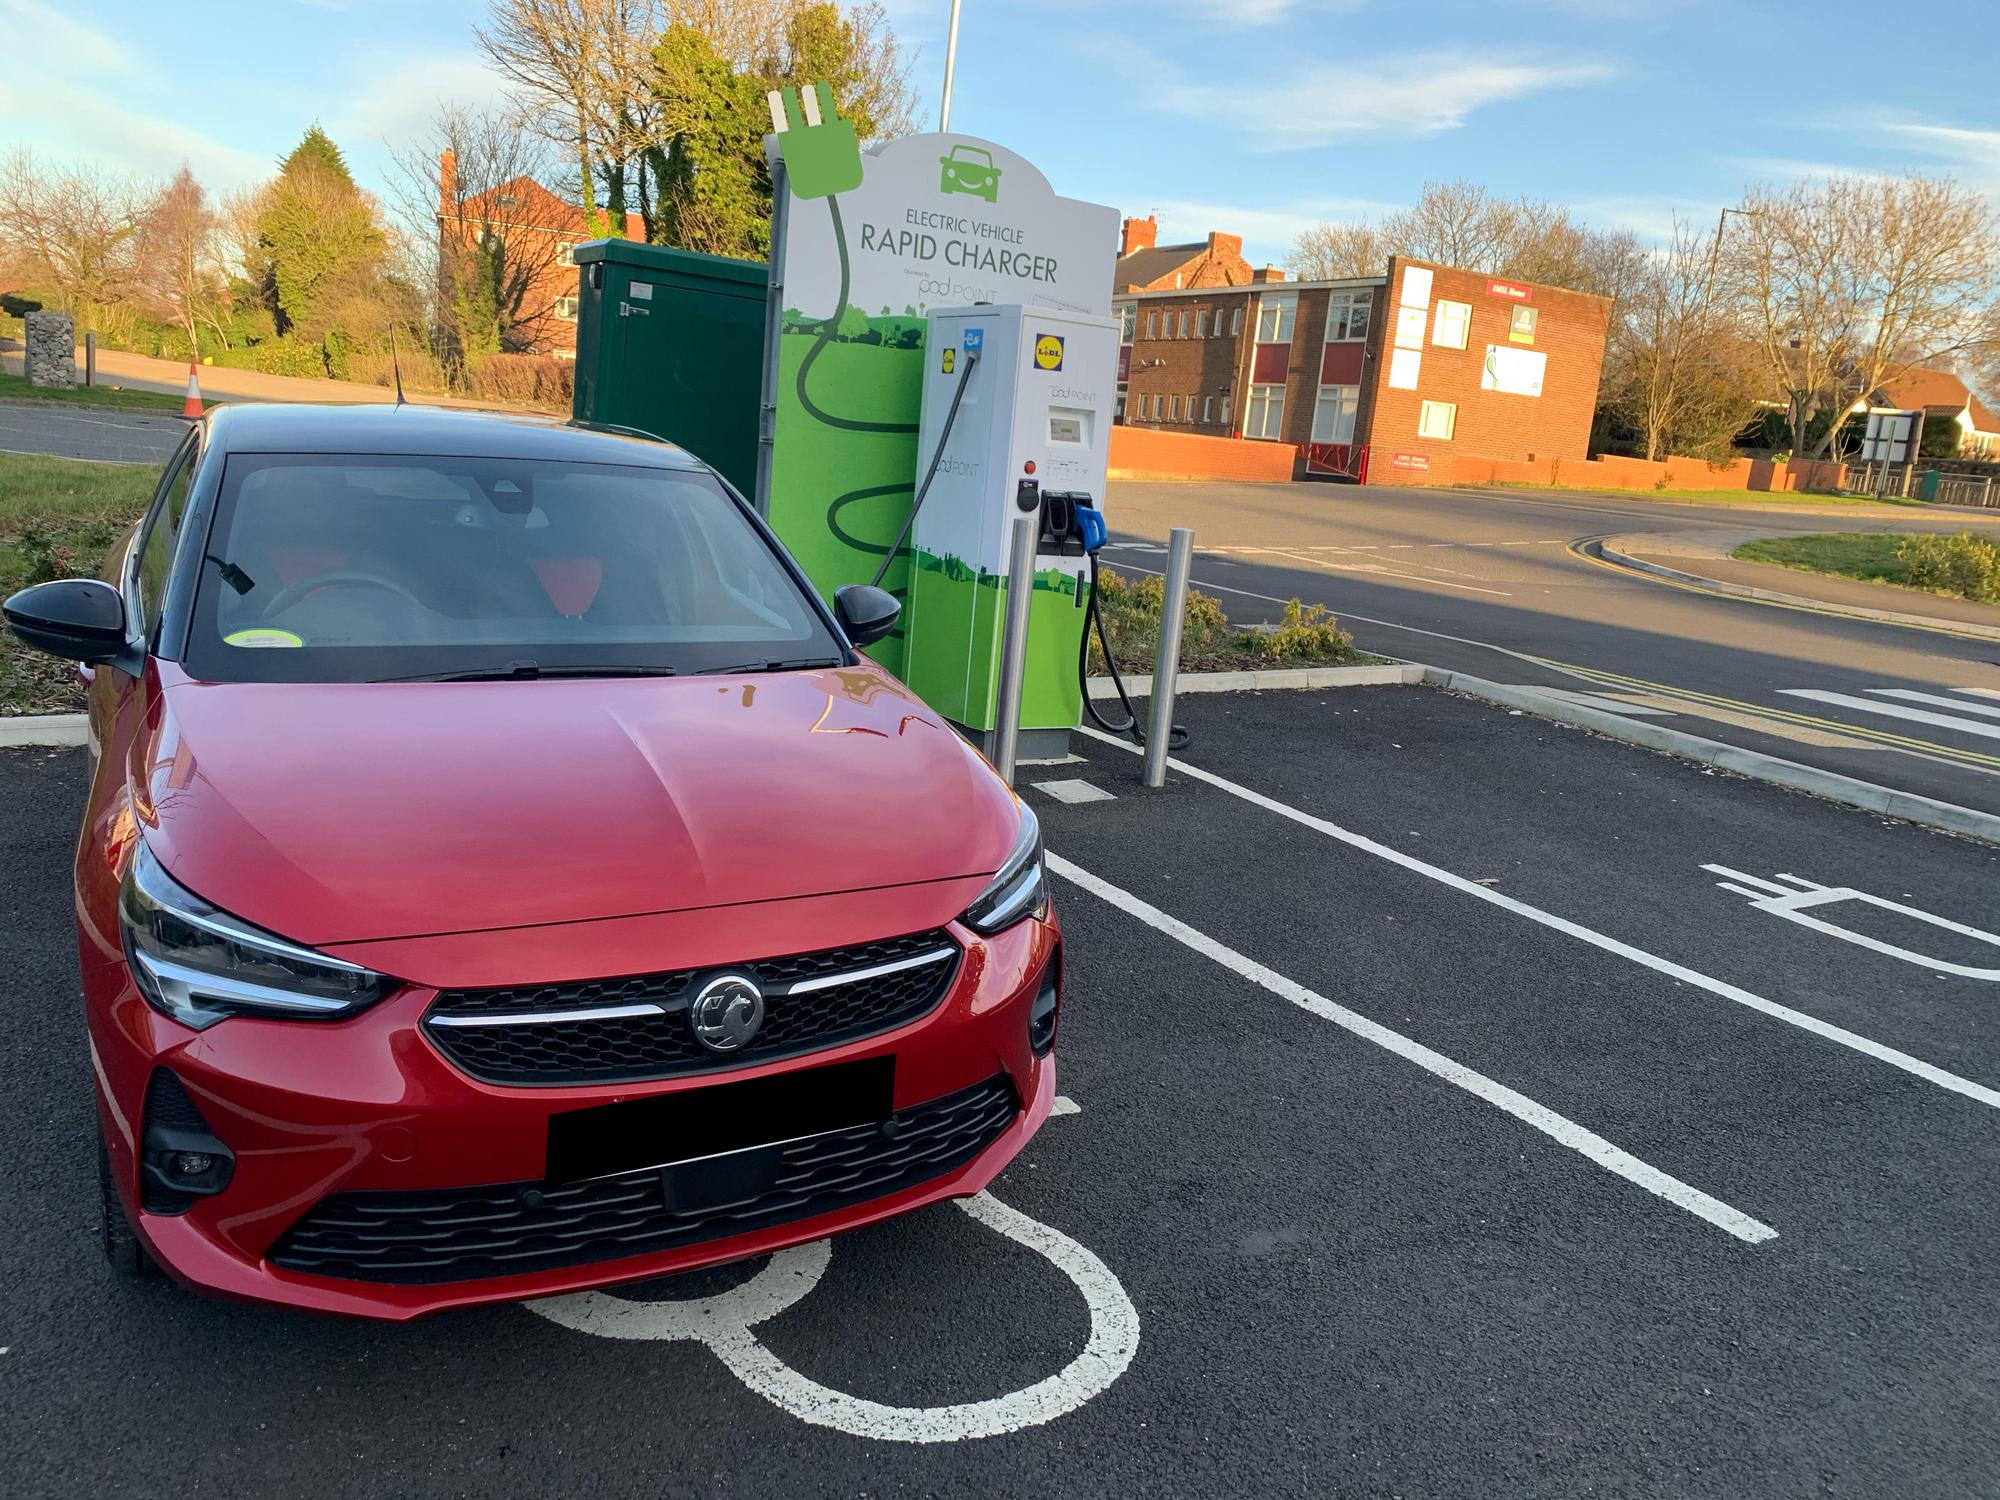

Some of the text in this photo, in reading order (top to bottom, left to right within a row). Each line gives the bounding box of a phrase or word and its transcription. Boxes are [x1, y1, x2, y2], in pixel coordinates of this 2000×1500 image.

[906, 208, 1025, 245] ELECTRIC VEHICLE
[861, 223, 1058, 284] RAPID CHARGER
[918, 276, 999, 304] pod POINT
